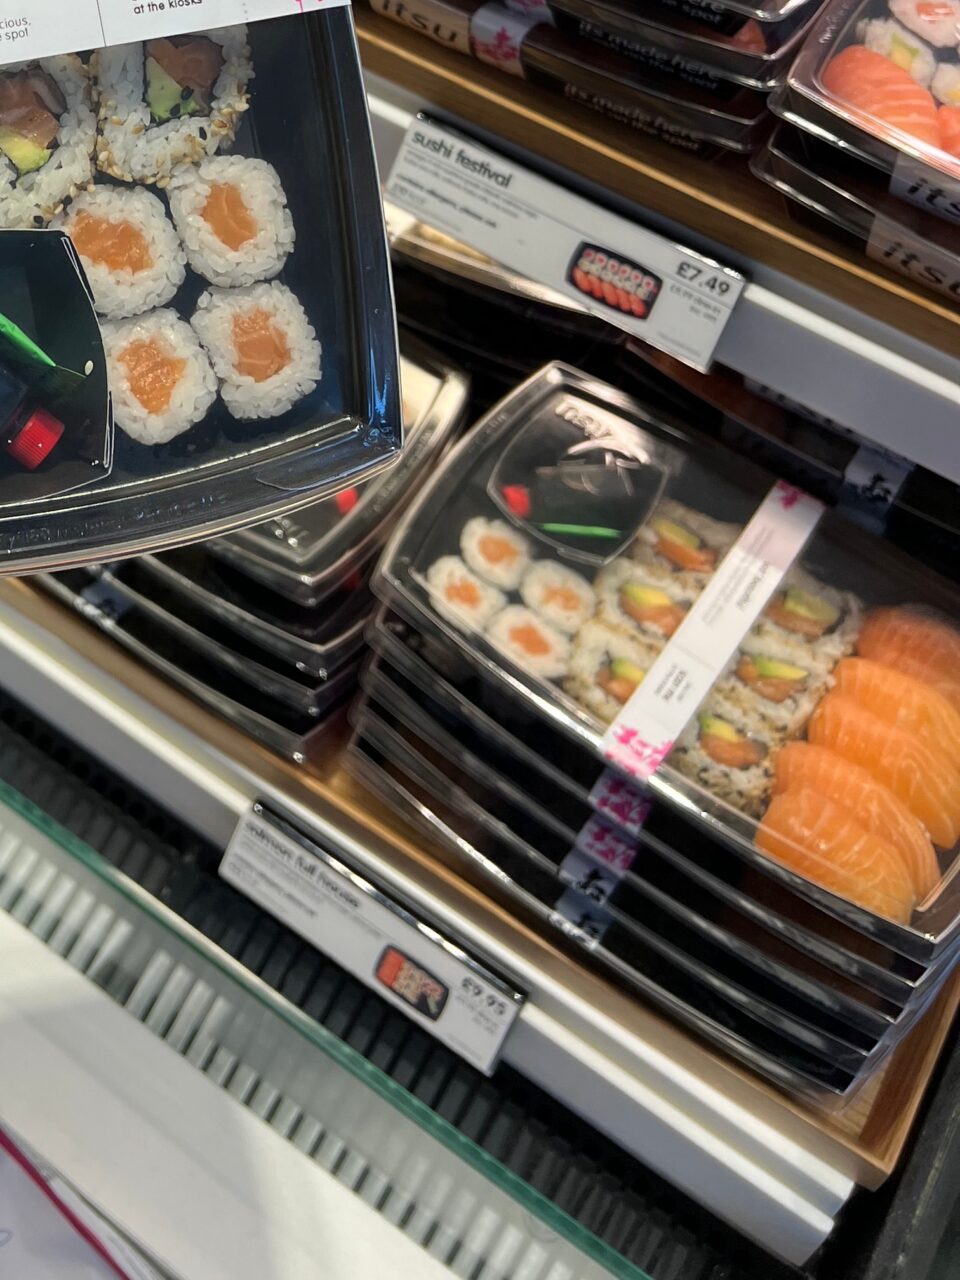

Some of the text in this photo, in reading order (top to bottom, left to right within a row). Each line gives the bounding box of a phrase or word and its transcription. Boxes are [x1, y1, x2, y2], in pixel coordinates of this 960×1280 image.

[133, 4, 144, 14] at
[147, 1, 165, 12] the
[5, 28, 29, 42] spot
[412, 131, 513, 188] sushi festival
[677, 261, 731, 297] £7.49
